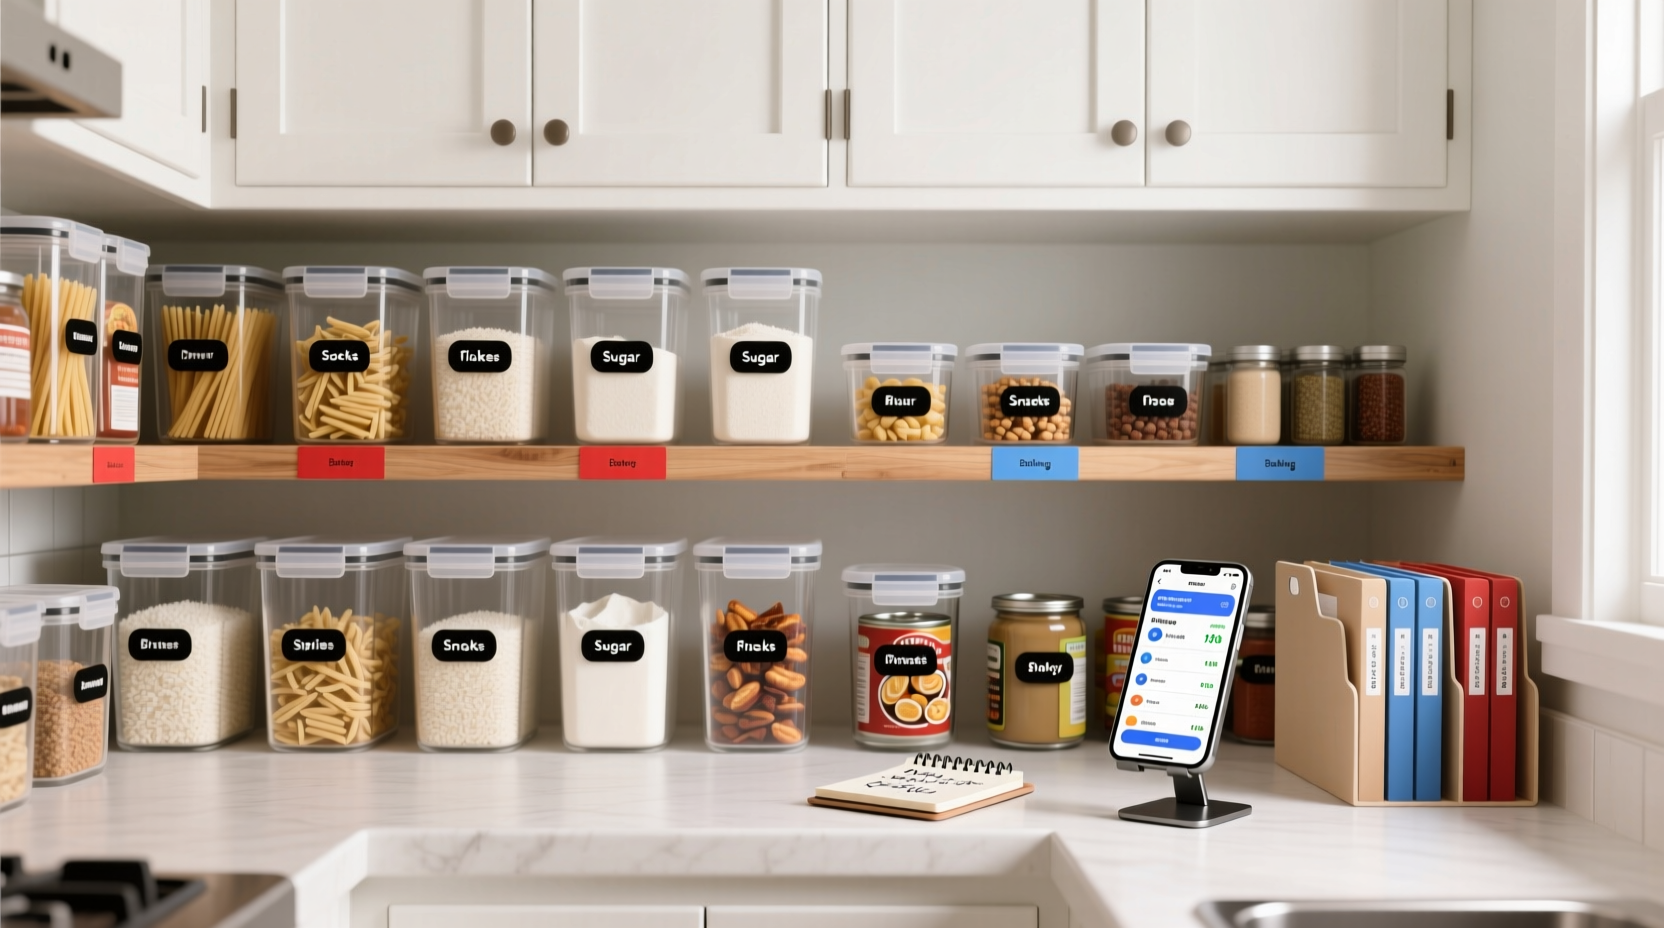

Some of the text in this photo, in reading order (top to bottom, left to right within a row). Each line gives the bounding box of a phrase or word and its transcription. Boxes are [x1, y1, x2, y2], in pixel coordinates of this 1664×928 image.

[603, 351, 641, 365] Sugar
[742, 351, 779, 366] Sugar
[595, 640, 633, 654] Sugar
